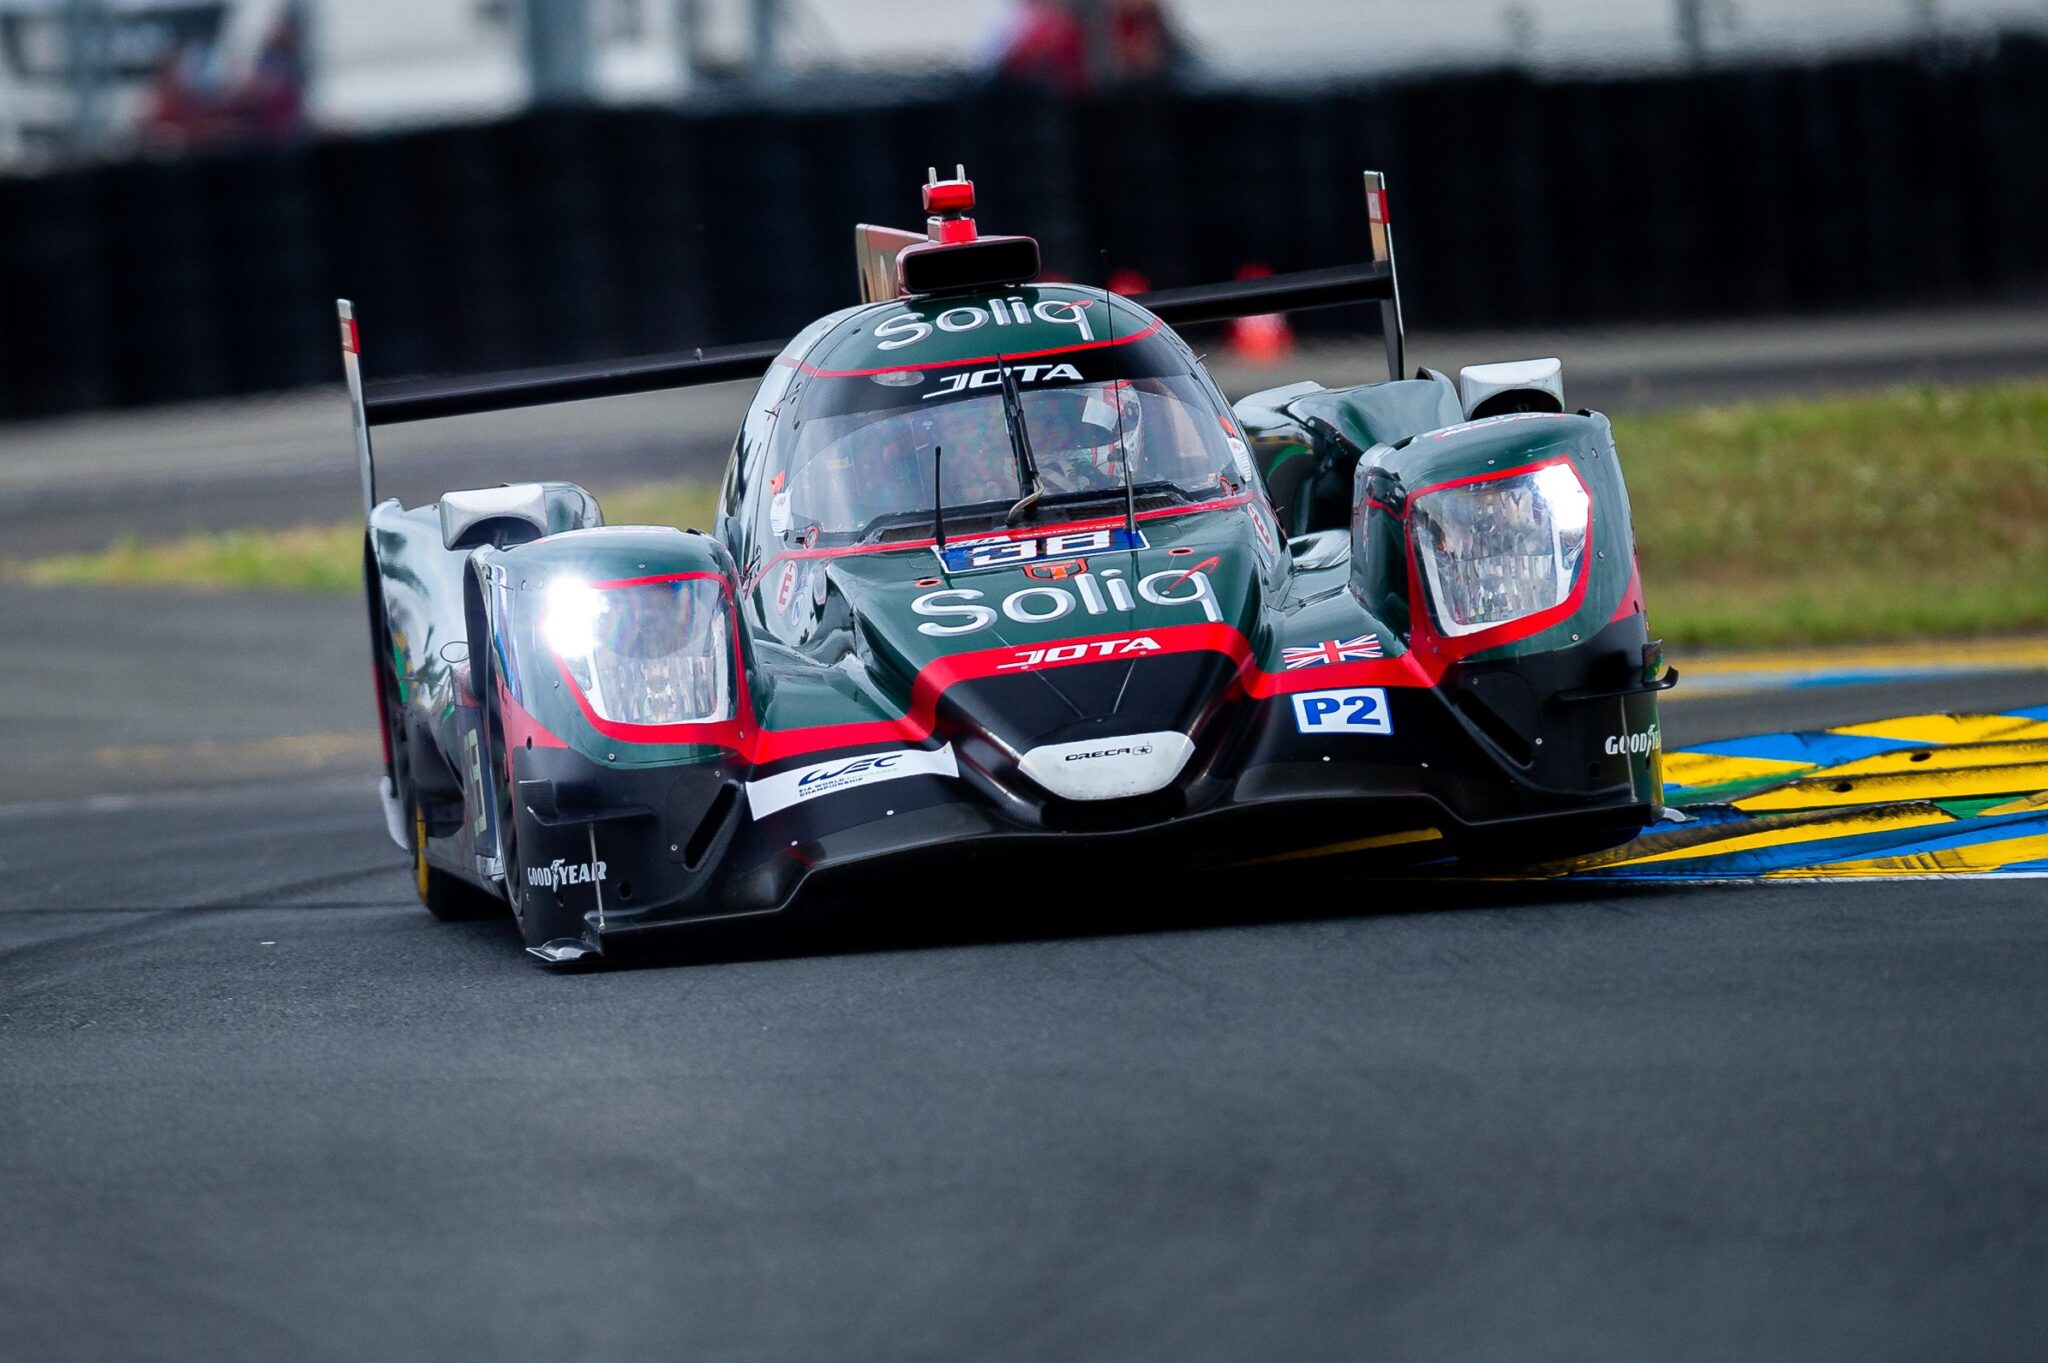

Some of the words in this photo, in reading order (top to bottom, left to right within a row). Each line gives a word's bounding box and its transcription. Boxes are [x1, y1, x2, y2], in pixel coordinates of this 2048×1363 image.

[873, 296, 1094, 350] Soliq
[922, 363, 1084, 399] JOTA
[972, 530, 1110, 567] 38
[911, 555, 1224, 637] Soliq
[996, 636, 1162, 669] JOTA
[1303, 695, 1382, 725] P2
[798, 754, 903, 786] WEC
[1065, 747, 1131, 761] ORECA
[527, 858, 607, 893] GOODYEAR
